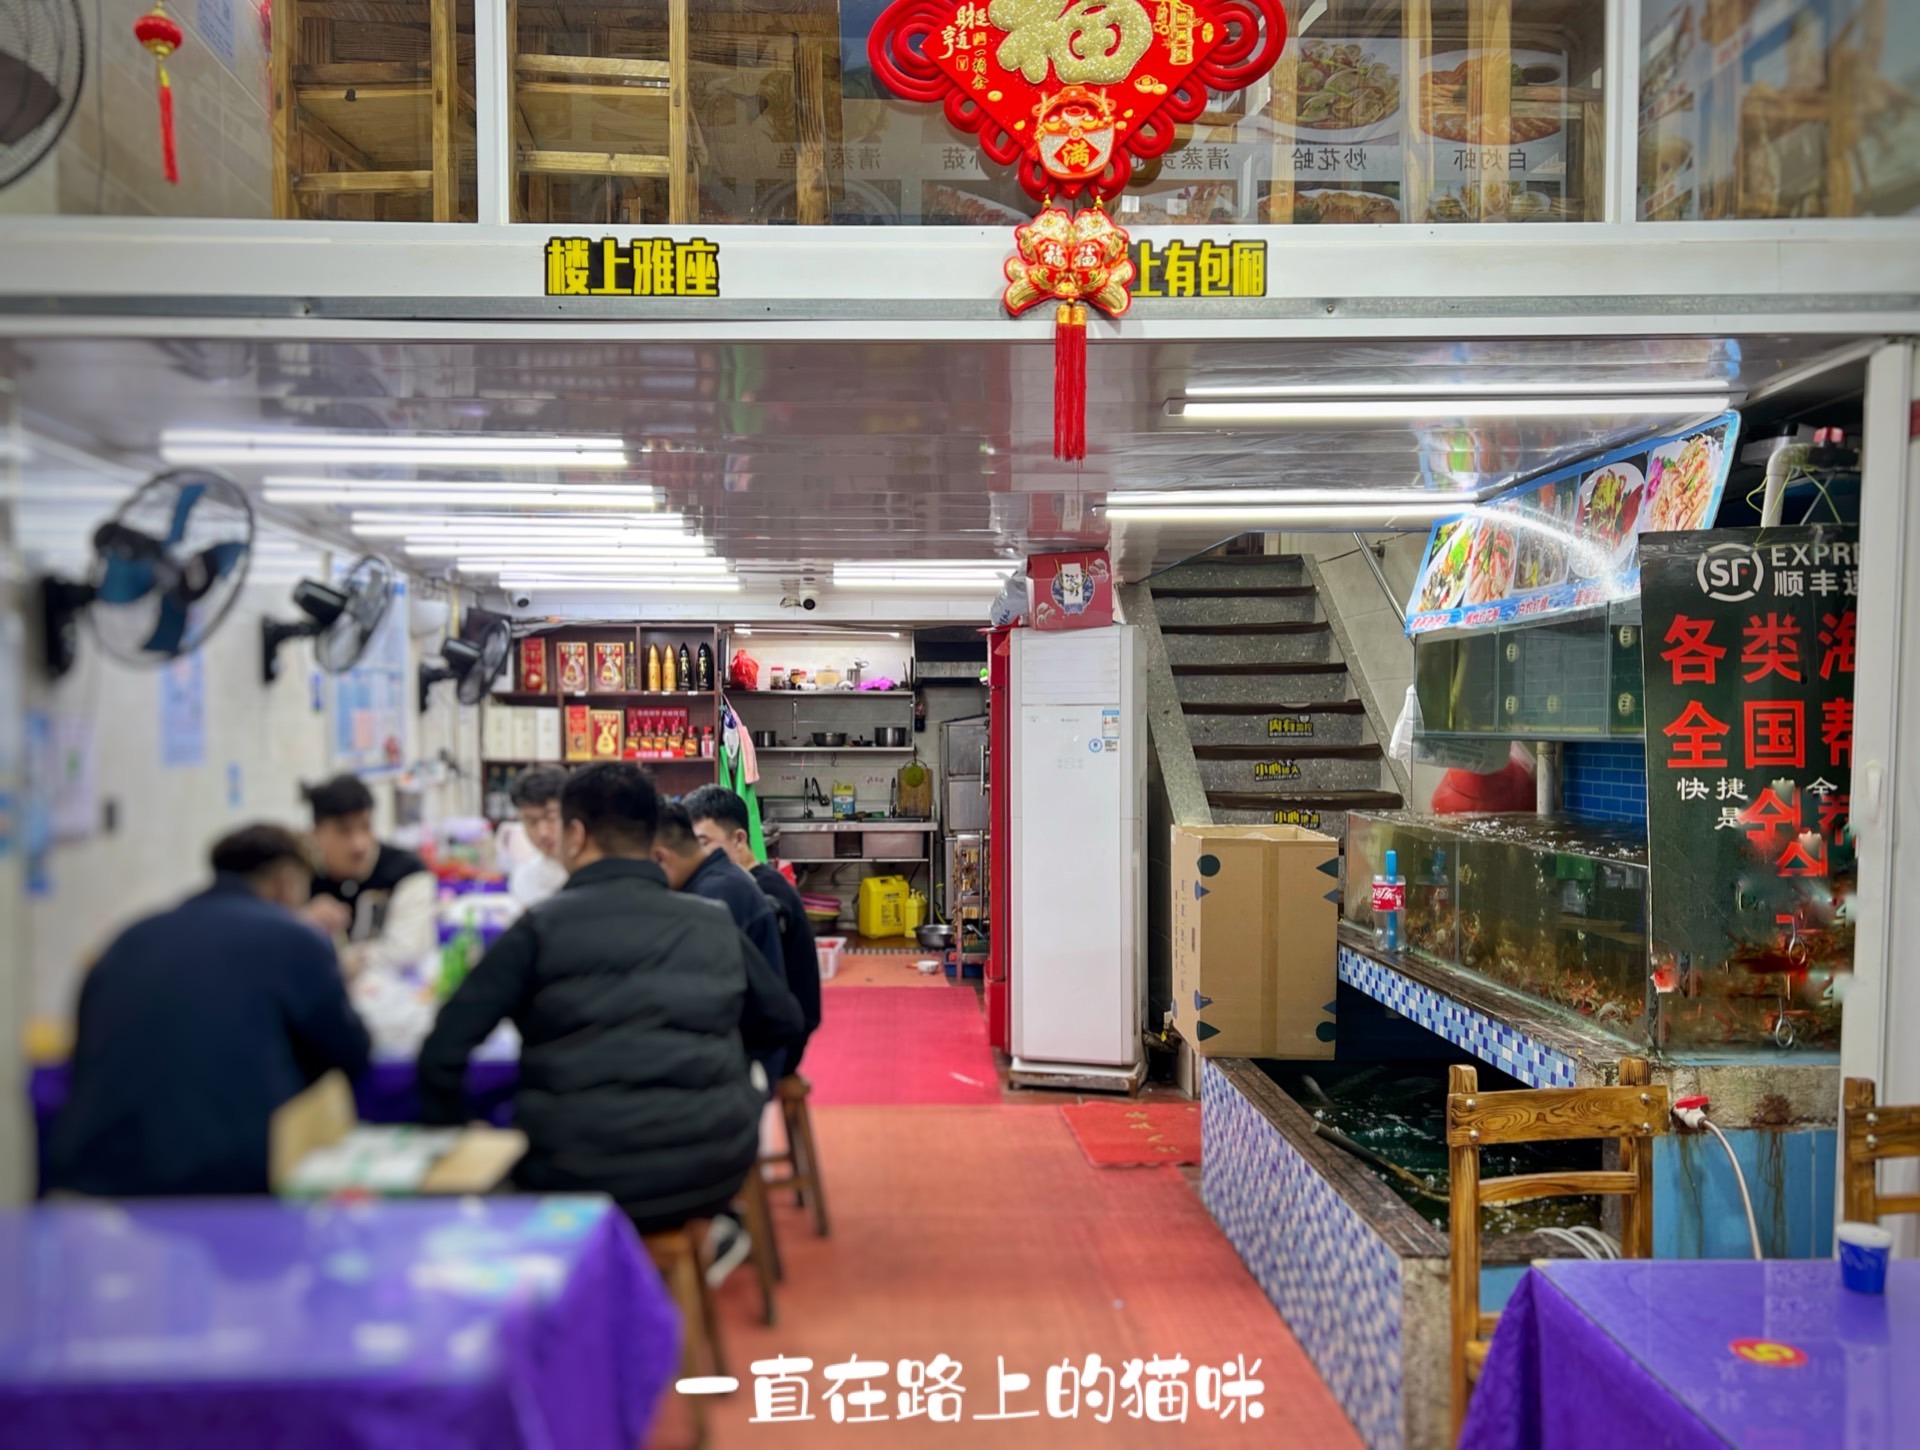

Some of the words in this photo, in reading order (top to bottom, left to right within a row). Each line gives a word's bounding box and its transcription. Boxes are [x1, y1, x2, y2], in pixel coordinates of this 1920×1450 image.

[988, 0, 1153, 84] 福
[1061, 141, 1090, 167] 满
[547, 239, 718, 296] 楼上雅座
[1125, 242, 1265, 297] 上有包厢
